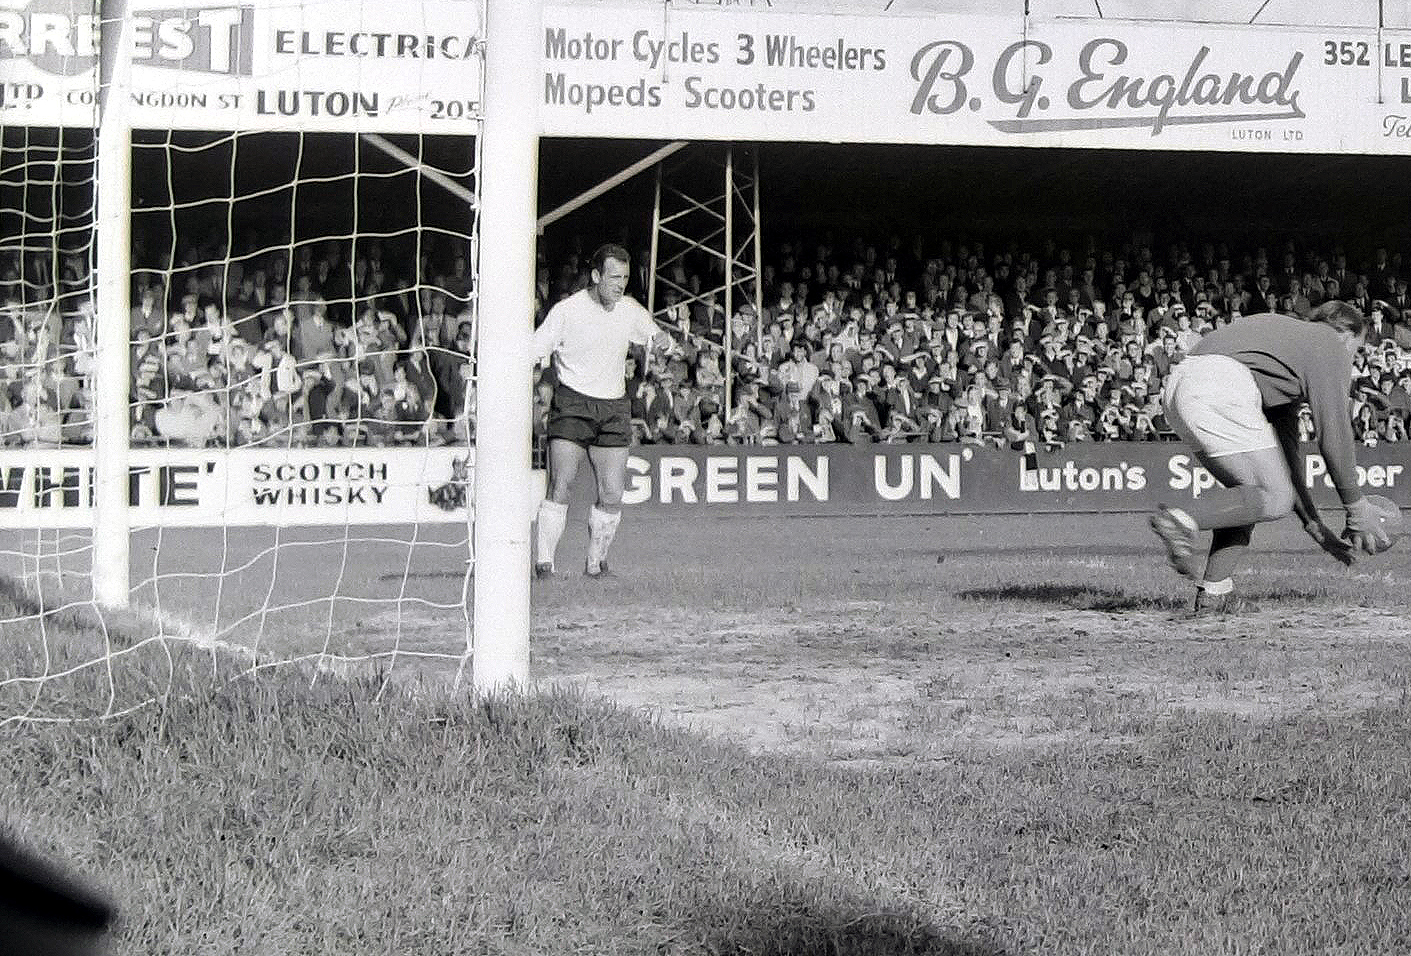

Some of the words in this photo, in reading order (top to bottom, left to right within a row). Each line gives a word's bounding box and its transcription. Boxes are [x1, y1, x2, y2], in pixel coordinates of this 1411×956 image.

[545, 28, 624, 61] Motor
[633, 30, 720, 69] Cycles
[736, 33, 755, 66] 3
[765, 35, 887, 71] Wheelers
[1324, 41, 1371, 67] 352
[256, 90, 379, 117] LUTON
[545, 73, 662, 114] Mopeds
[684, 76, 816, 112] Scooters
[1067, 38, 1304, 137] England
[1231, 129, 1273, 141] LUTON
[253, 462, 389, 482] SCOTCH
[621, 455, 829, 504] GREEN
[1019, 454, 1147, 492] Luton's
[253, 486, 389, 506] WHISKY
